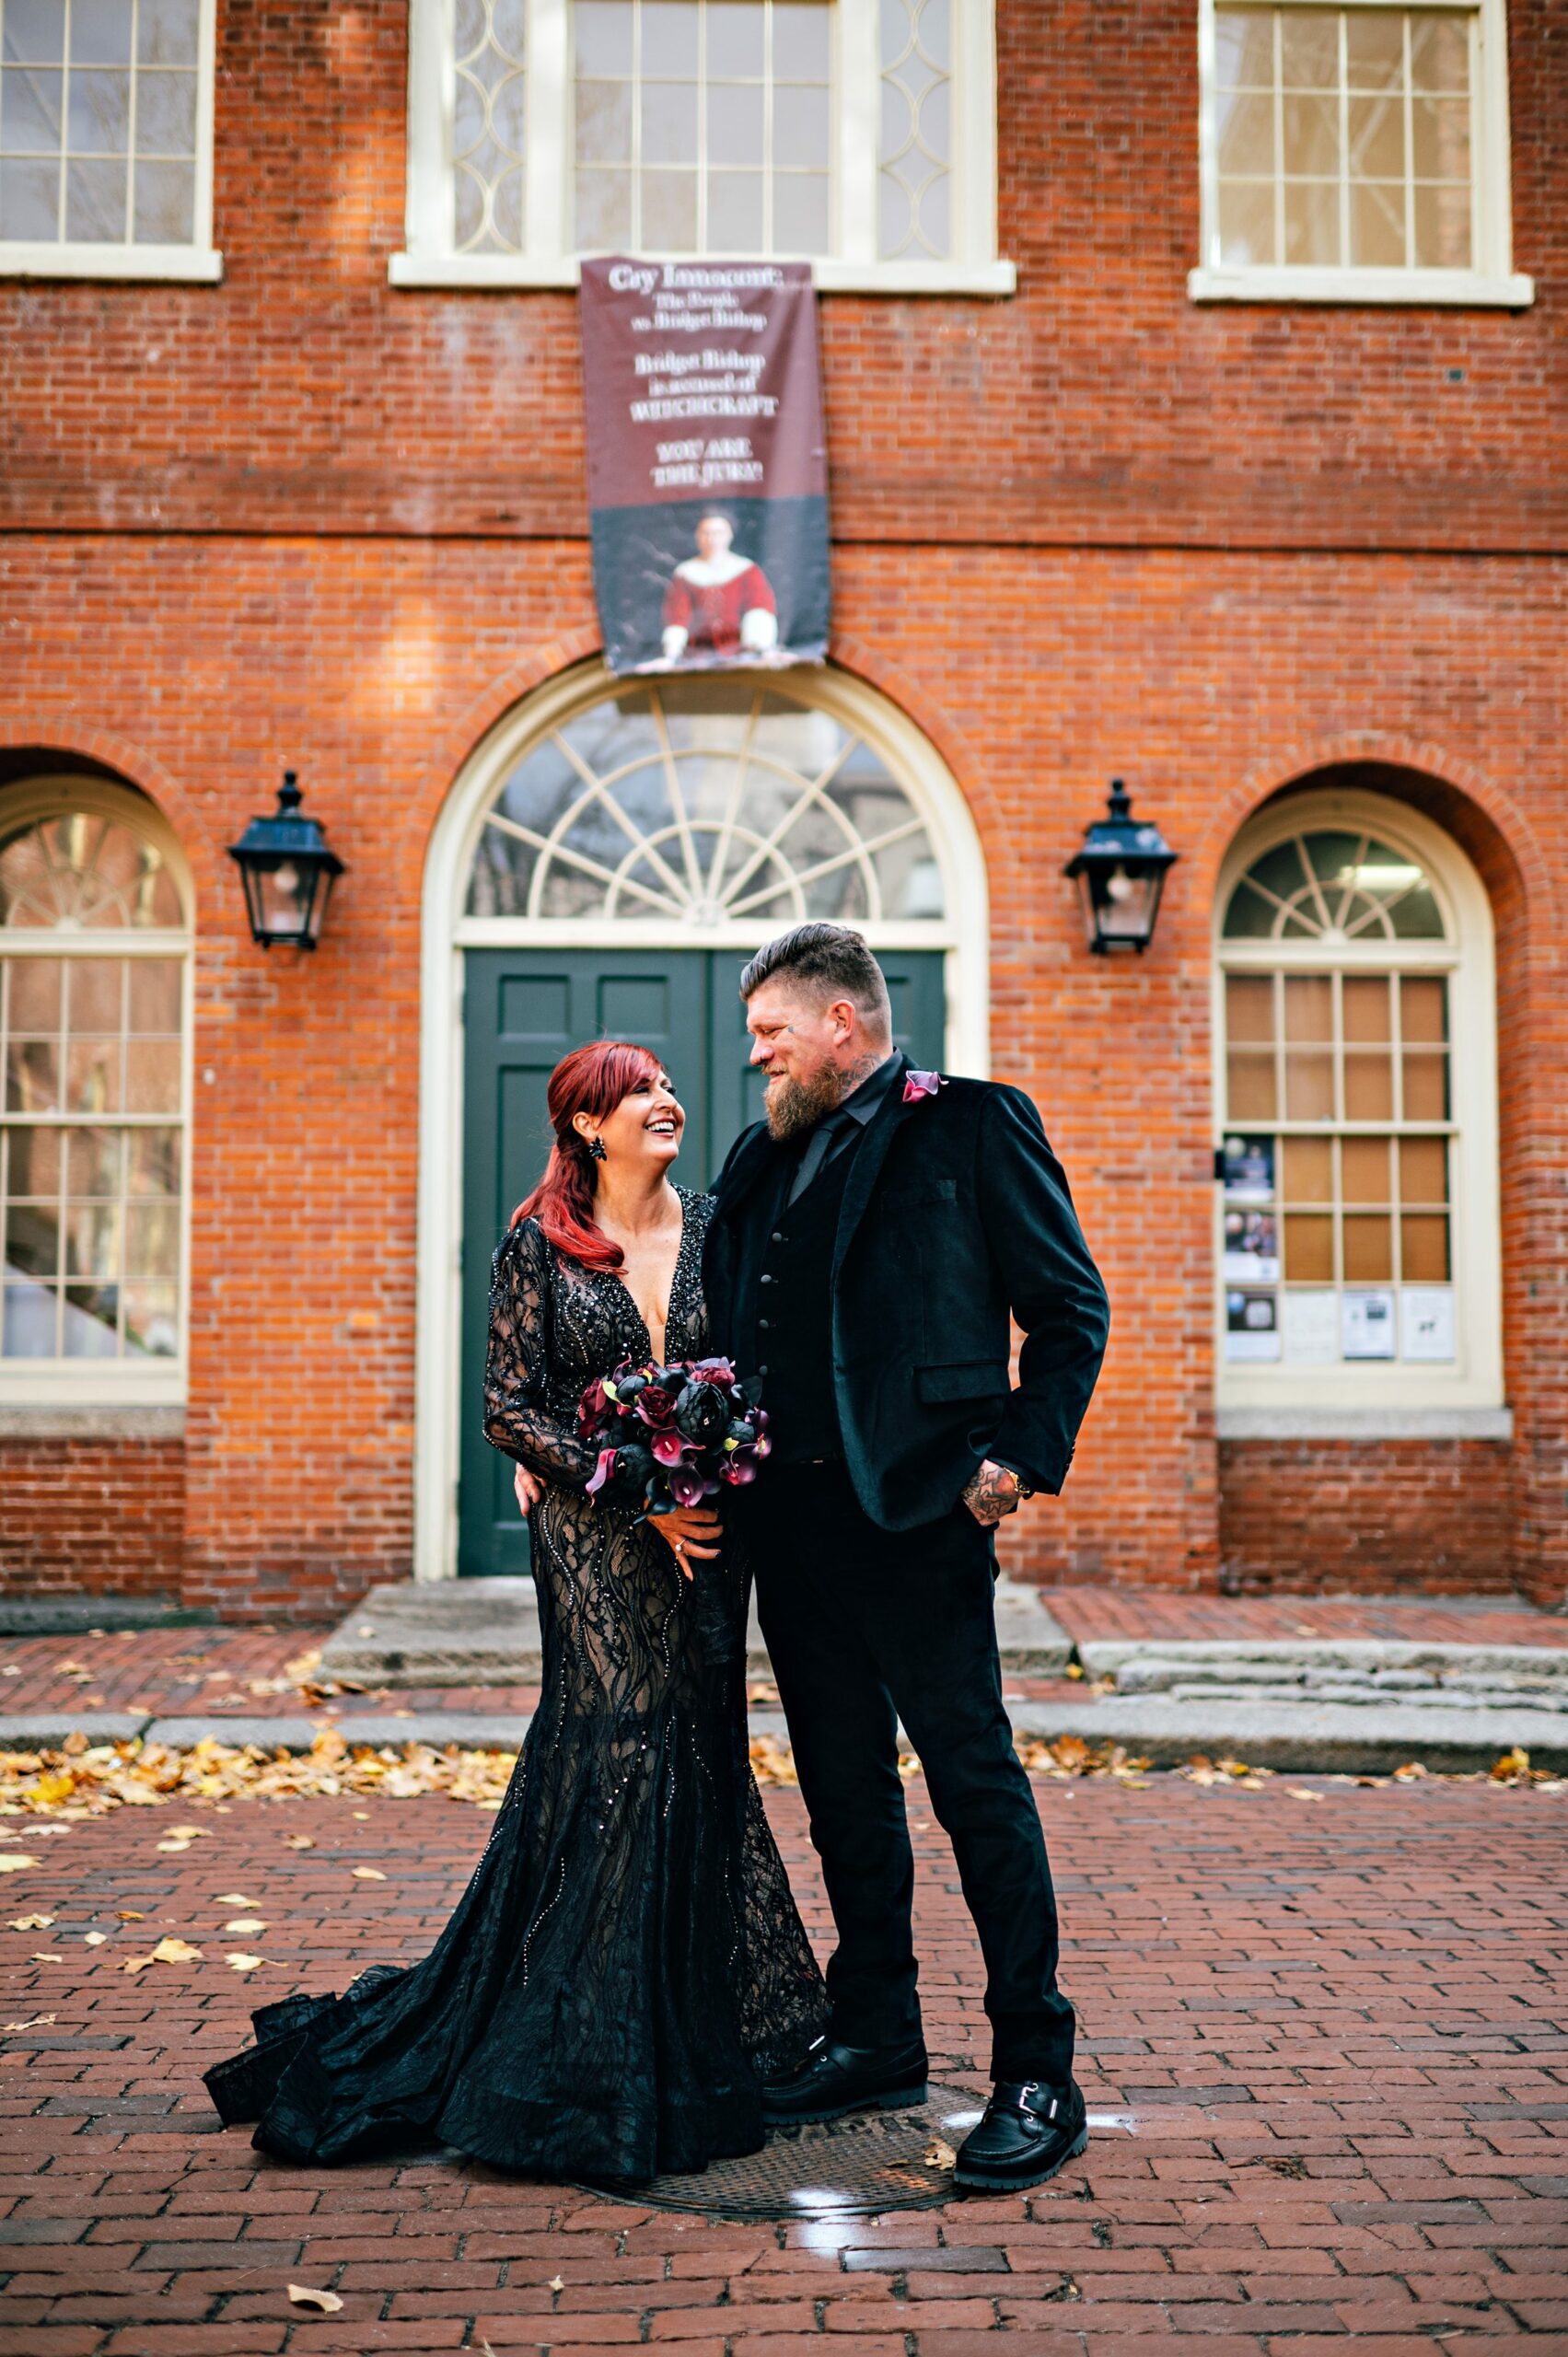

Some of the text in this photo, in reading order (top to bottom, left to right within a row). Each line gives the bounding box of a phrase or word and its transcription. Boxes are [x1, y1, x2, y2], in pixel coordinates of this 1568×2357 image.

[609, 264, 658, 294] Cry
[635, 350, 766, 375] Bridget Bishop
[631, 396, 780, 422] WITCHCRAFT
